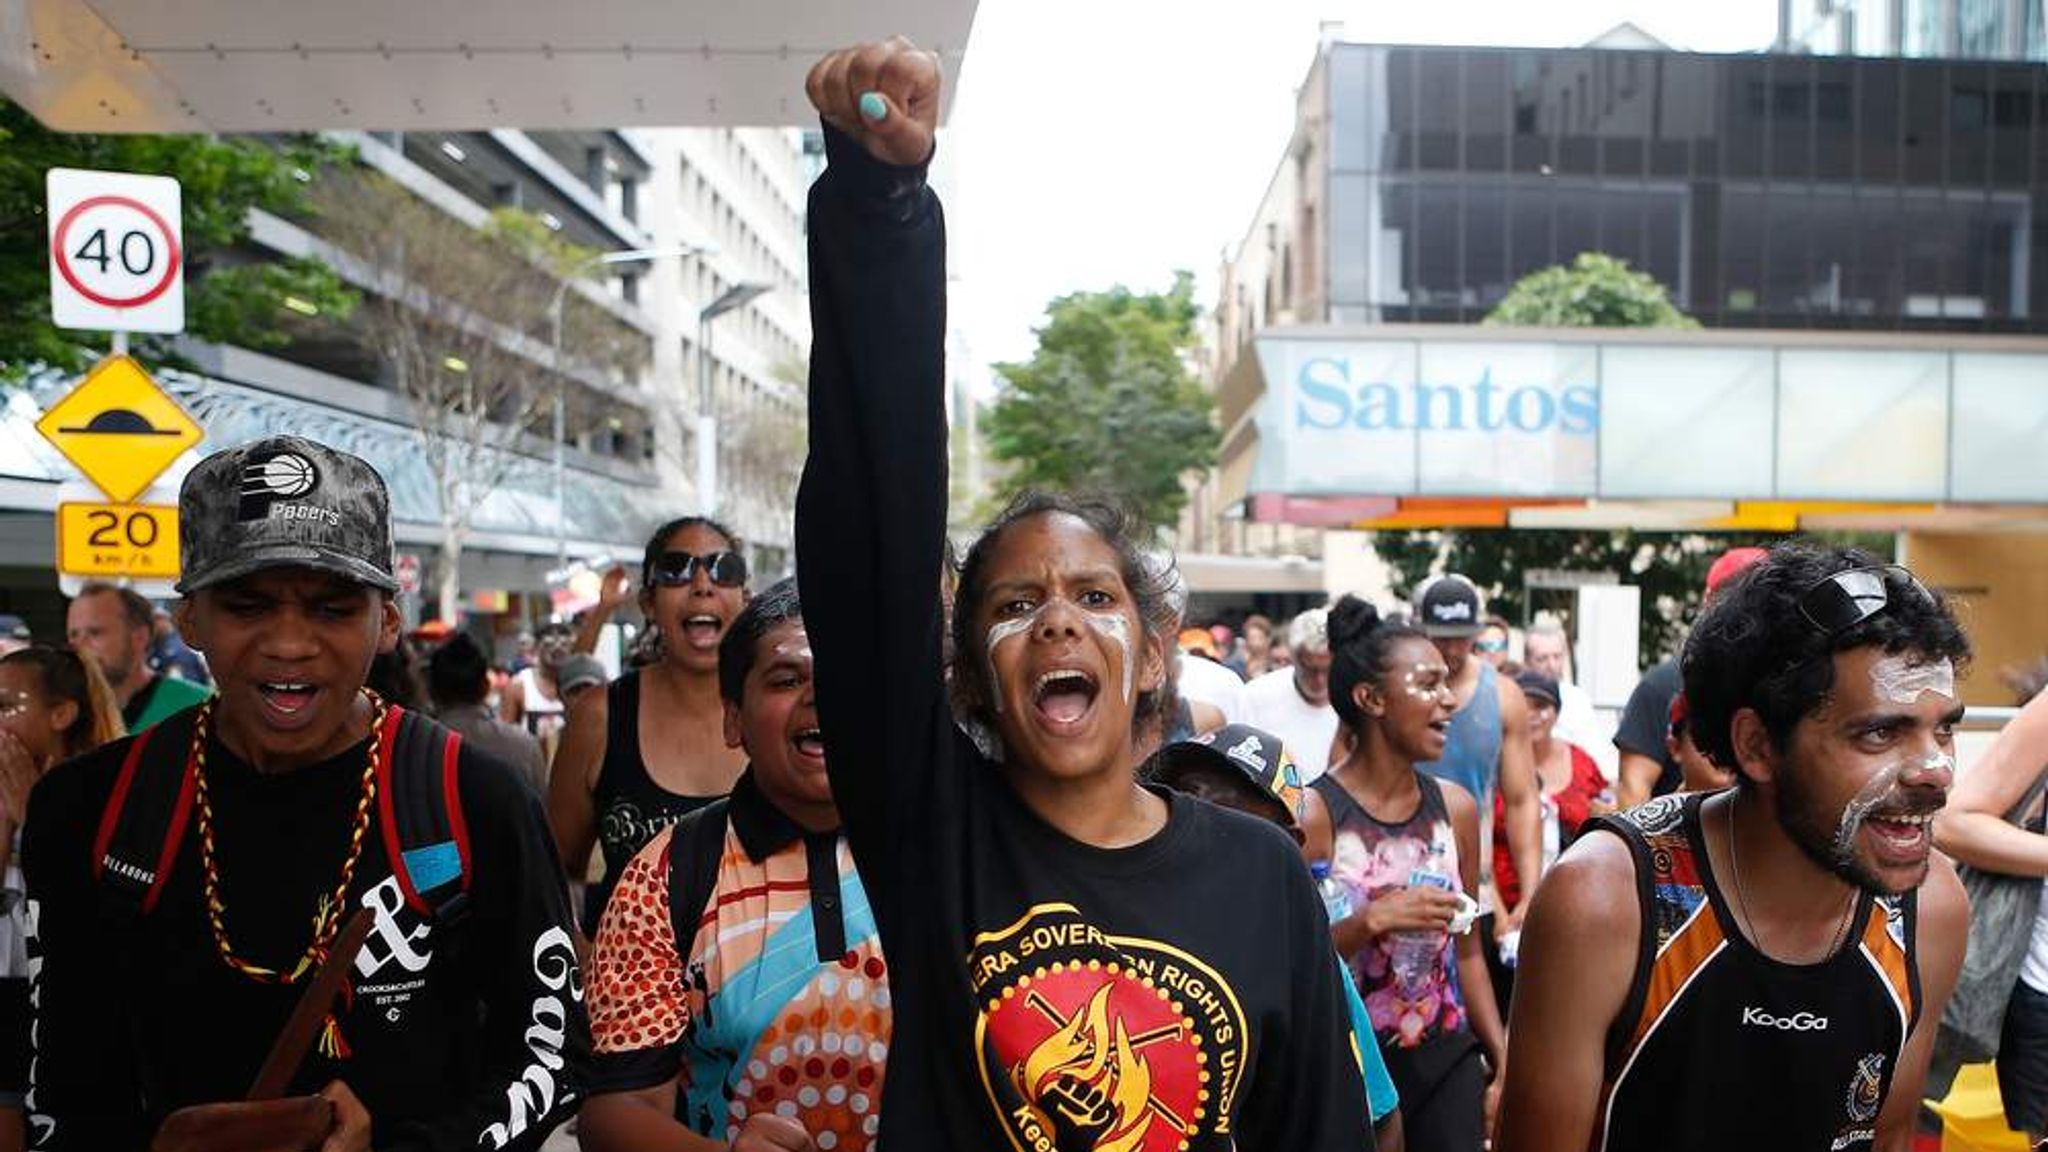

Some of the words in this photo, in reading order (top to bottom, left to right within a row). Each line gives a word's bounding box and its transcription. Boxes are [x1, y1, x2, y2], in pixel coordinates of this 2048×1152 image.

[75, 228, 155, 276] 40
[1296, 358, 1600, 435] Santos
[87, 510, 158, 548] 20
[268, 503, 339, 526] Pacers
[971, 950, 1020, 994] ERA
[1160, 964, 1233, 1045] RIGHTS
[1742, 1006, 1829, 1031] KooGa
[1013, 1104, 1059, 1152] Kee
